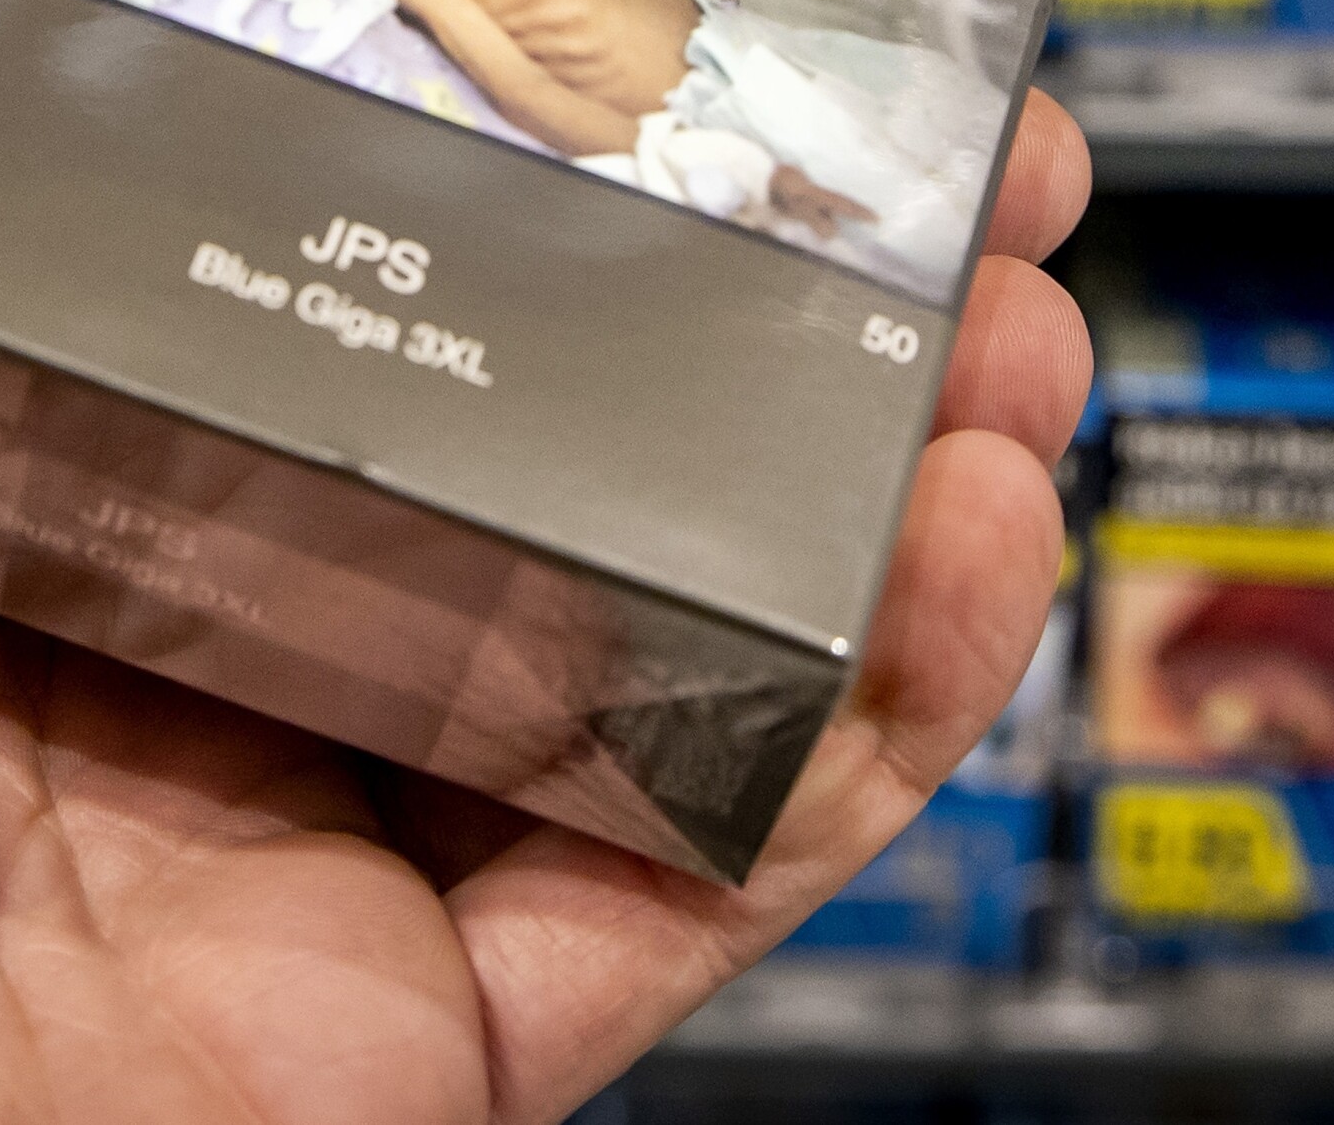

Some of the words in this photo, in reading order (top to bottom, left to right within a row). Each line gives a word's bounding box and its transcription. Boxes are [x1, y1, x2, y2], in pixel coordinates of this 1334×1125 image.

[299, 216, 431, 295] JPS
[188, 241, 290, 309] Blue
[294, 281, 399, 351] Giga
[402, 321, 494, 388] 3XL
[859, 313, 919, 364] 50
